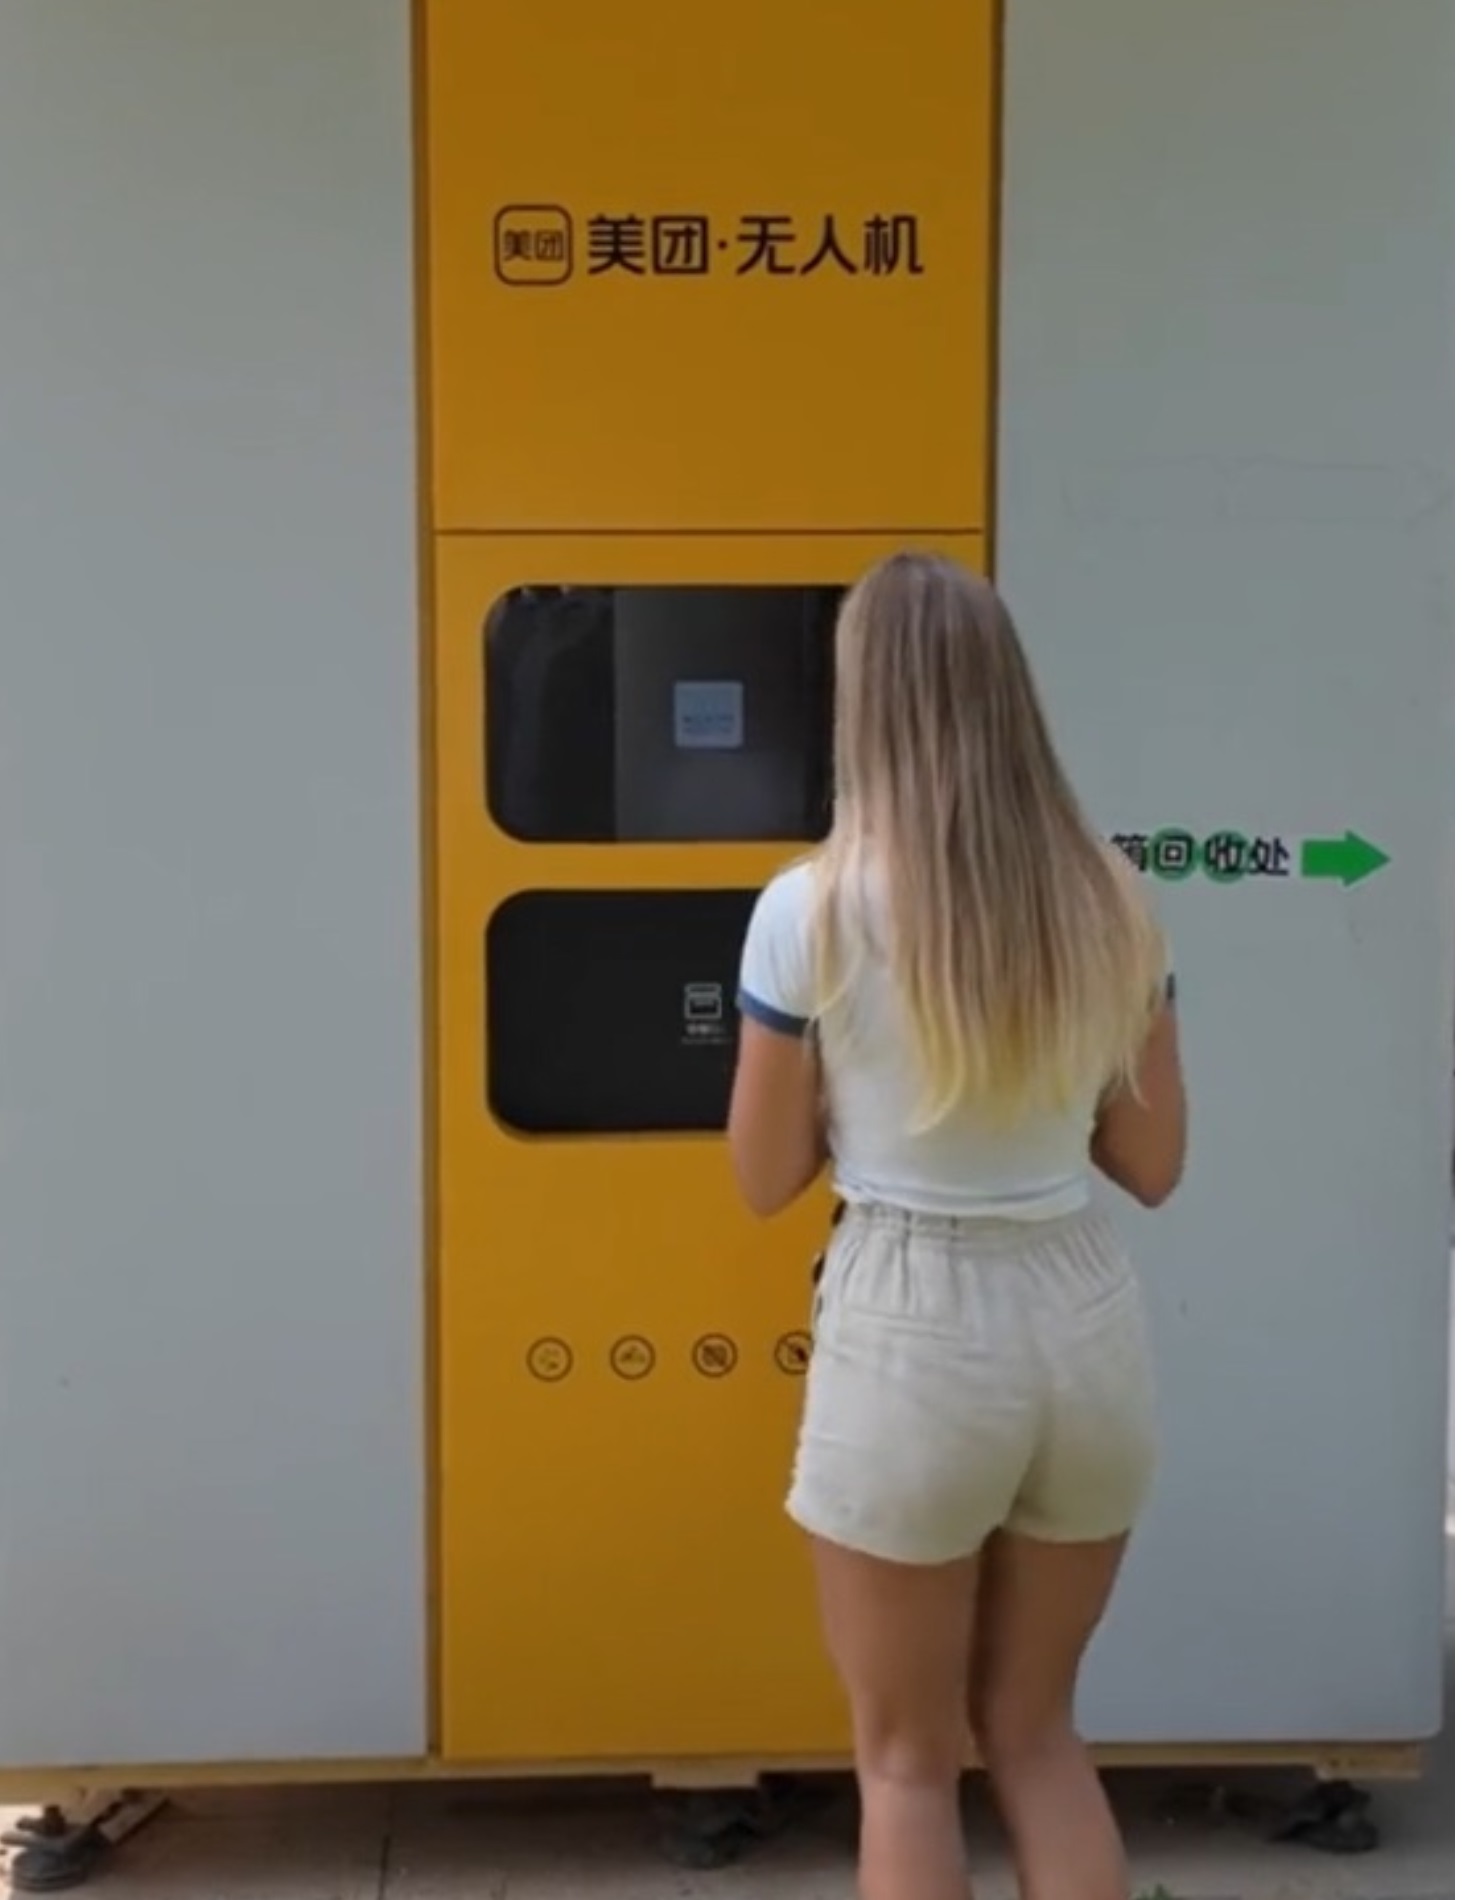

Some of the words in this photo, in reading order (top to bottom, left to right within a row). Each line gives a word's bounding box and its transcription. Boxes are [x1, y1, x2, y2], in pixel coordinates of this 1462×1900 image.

[503, 230, 563, 261] 美团
[587, 214, 924, 275] 美团·无人机
